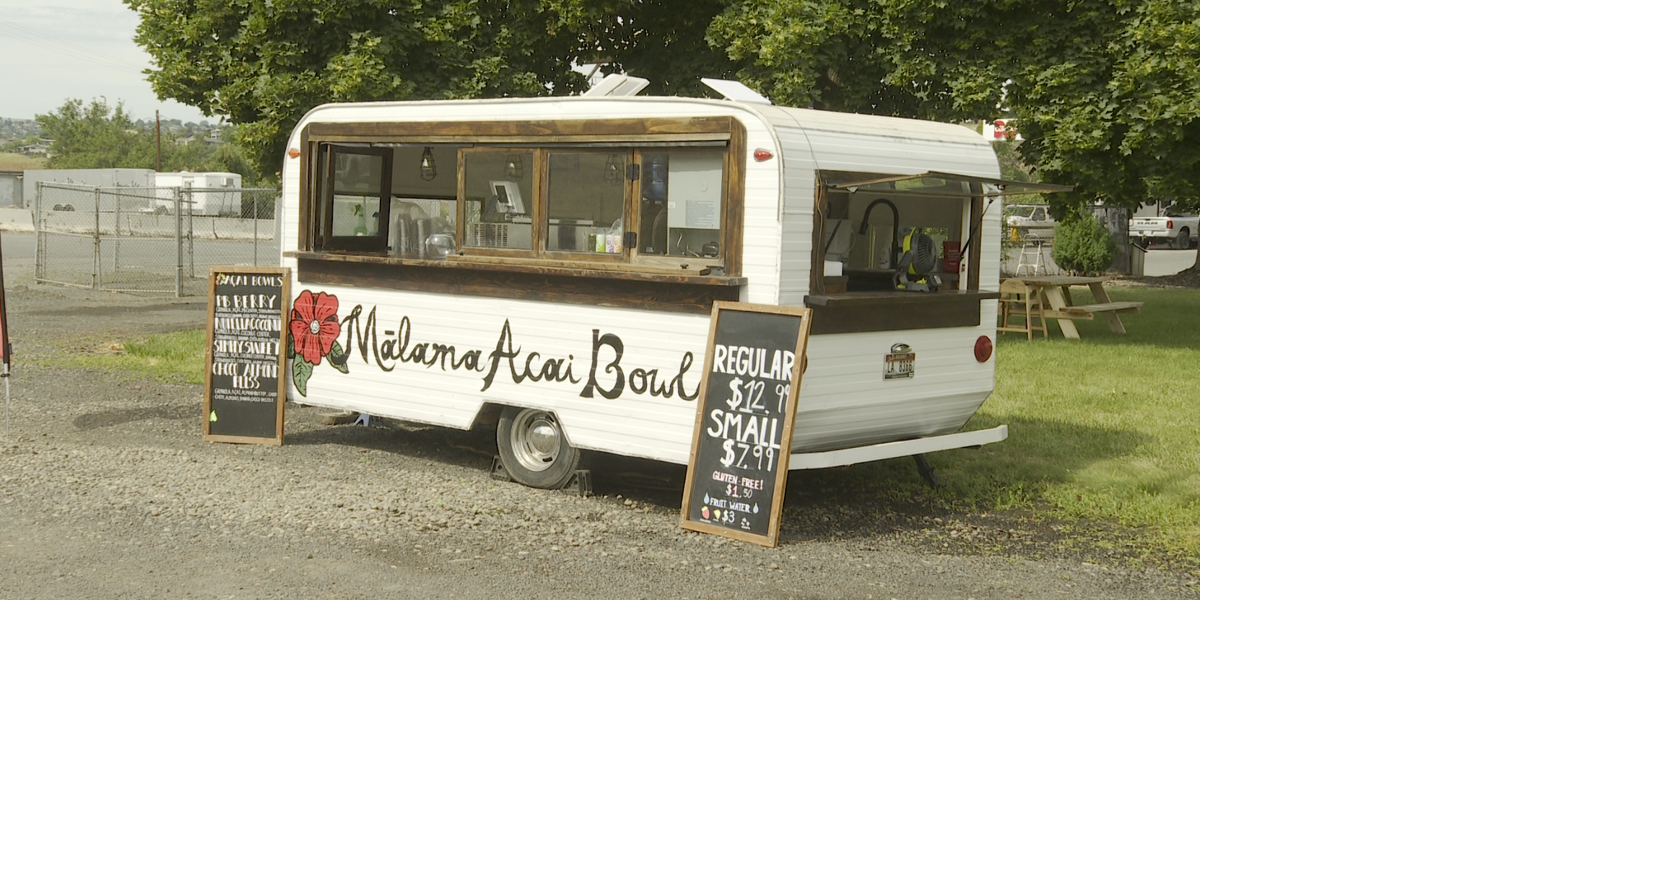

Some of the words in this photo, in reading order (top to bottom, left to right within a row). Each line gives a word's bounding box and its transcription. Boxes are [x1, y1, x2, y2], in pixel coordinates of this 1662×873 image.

[252, 276, 283, 287] BOWLS
[216, 295, 231, 308] PB
[234, 294, 277, 309] BERRY
[244, 341, 280, 355] SWEET
[481, 318, 582, 391] Acai
[212, 362, 239, 376] CHOCO
[243, 363, 280, 378] ALMOND
[713, 344, 795, 381] REGULAR
[232, 375, 261, 389] BLISS
[707, 408, 781, 449] SMALL
[720, 439, 774, 472] $7.99
[709, 497, 727, 509] FRUIT
[729, 501, 751, 513] WATER
[721, 509, 735, 523] $3
